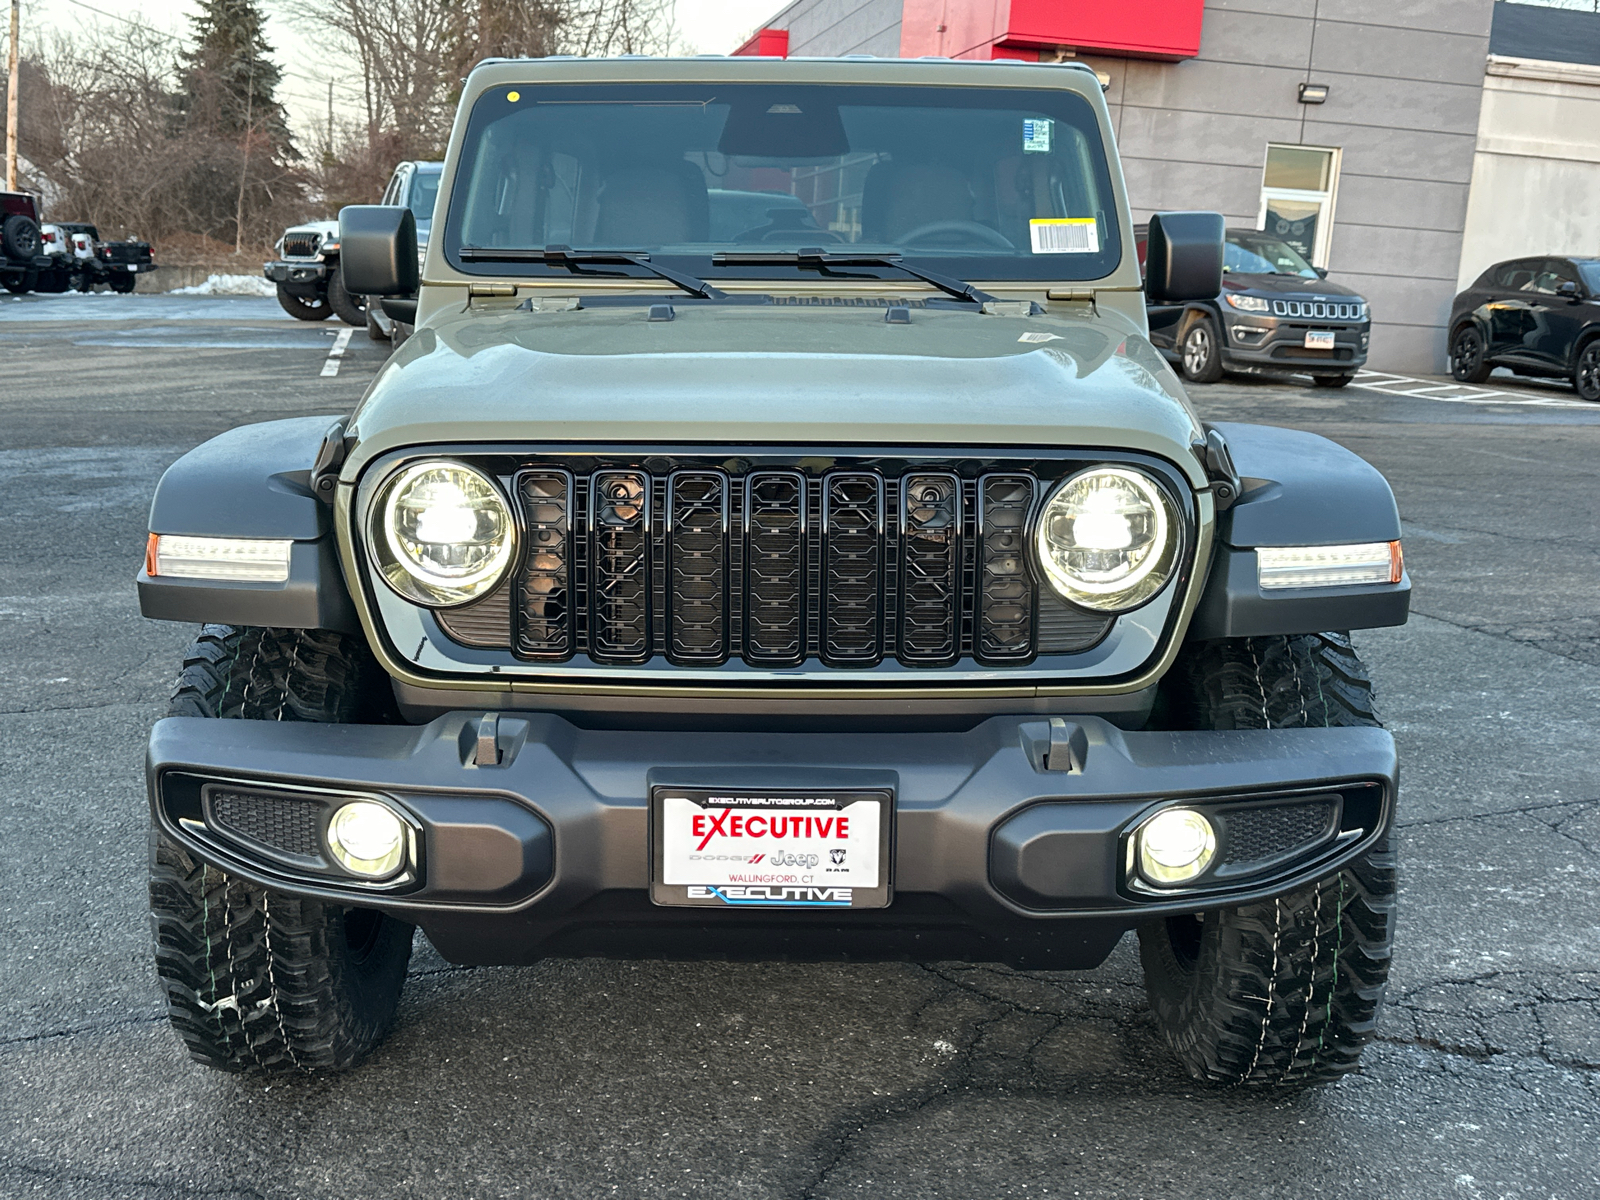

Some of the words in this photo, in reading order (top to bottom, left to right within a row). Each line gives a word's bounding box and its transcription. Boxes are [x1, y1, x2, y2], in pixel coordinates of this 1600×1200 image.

[708, 797, 835, 805] EXECUTIVEAUTOGROUP.COM
[692, 808, 849, 851] EXECUTIVE
[770, 850, 819, 869] Jeep
[729, 874, 799, 884] WALLINGFORD,
[802, 875, 814, 883] CT
[687, 886, 852, 904] EXECUTIVE
